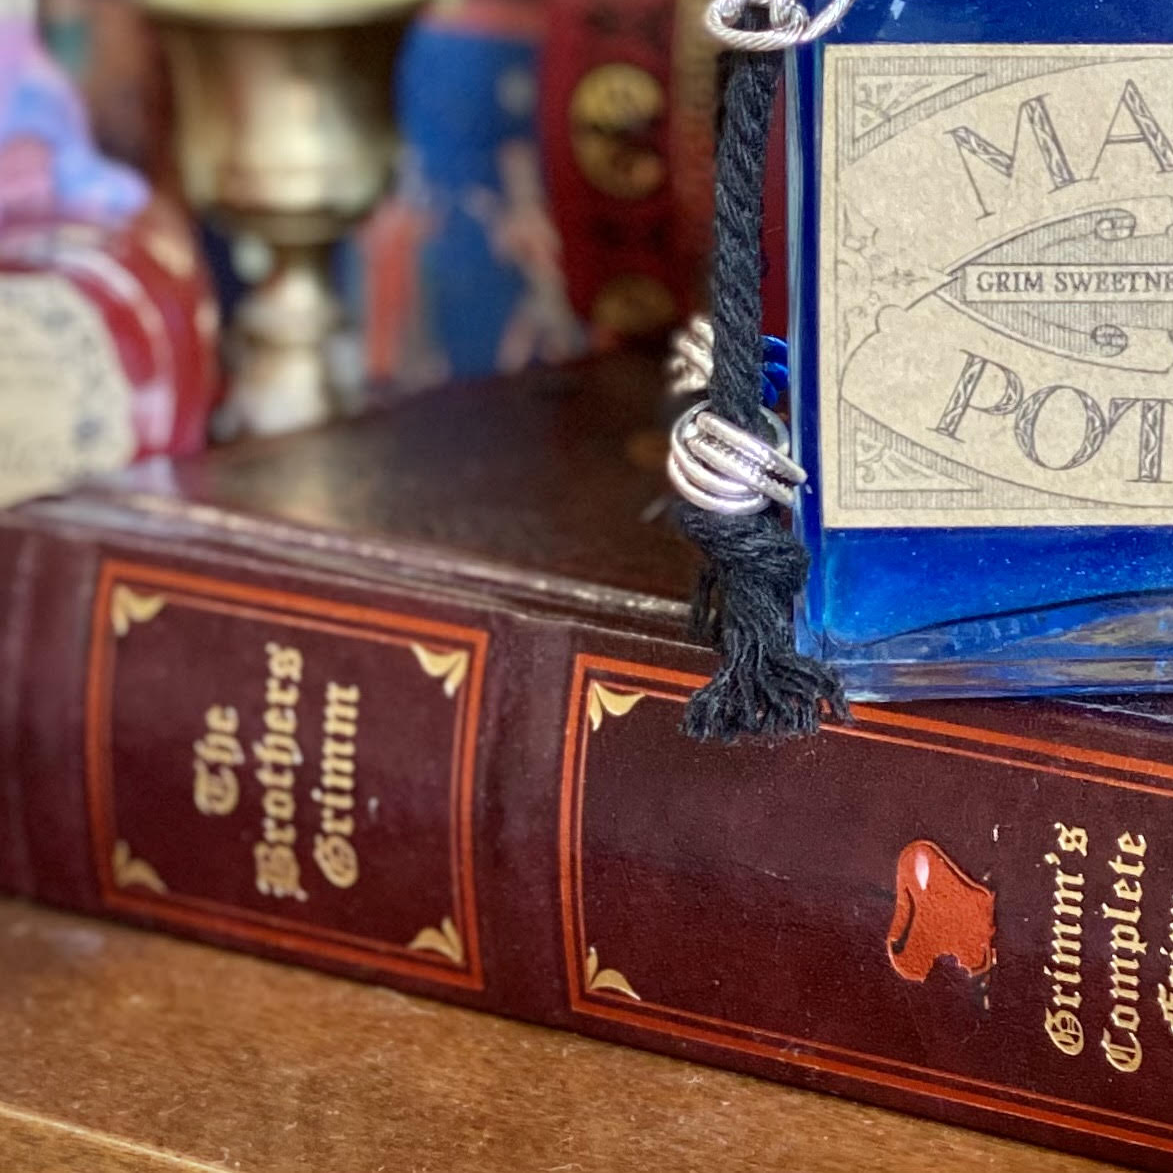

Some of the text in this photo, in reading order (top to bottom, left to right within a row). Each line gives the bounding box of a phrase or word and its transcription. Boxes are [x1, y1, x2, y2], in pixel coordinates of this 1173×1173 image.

[975, 270, 1044, 294] GRIM
[193, 704, 245, 817] The
[252, 641, 309, 902] Brothers
[310, 681, 361, 888] Grimm
[1043, 822, 1089, 1056] Grimm's
[1100, 830, 1148, 1073] Complete
